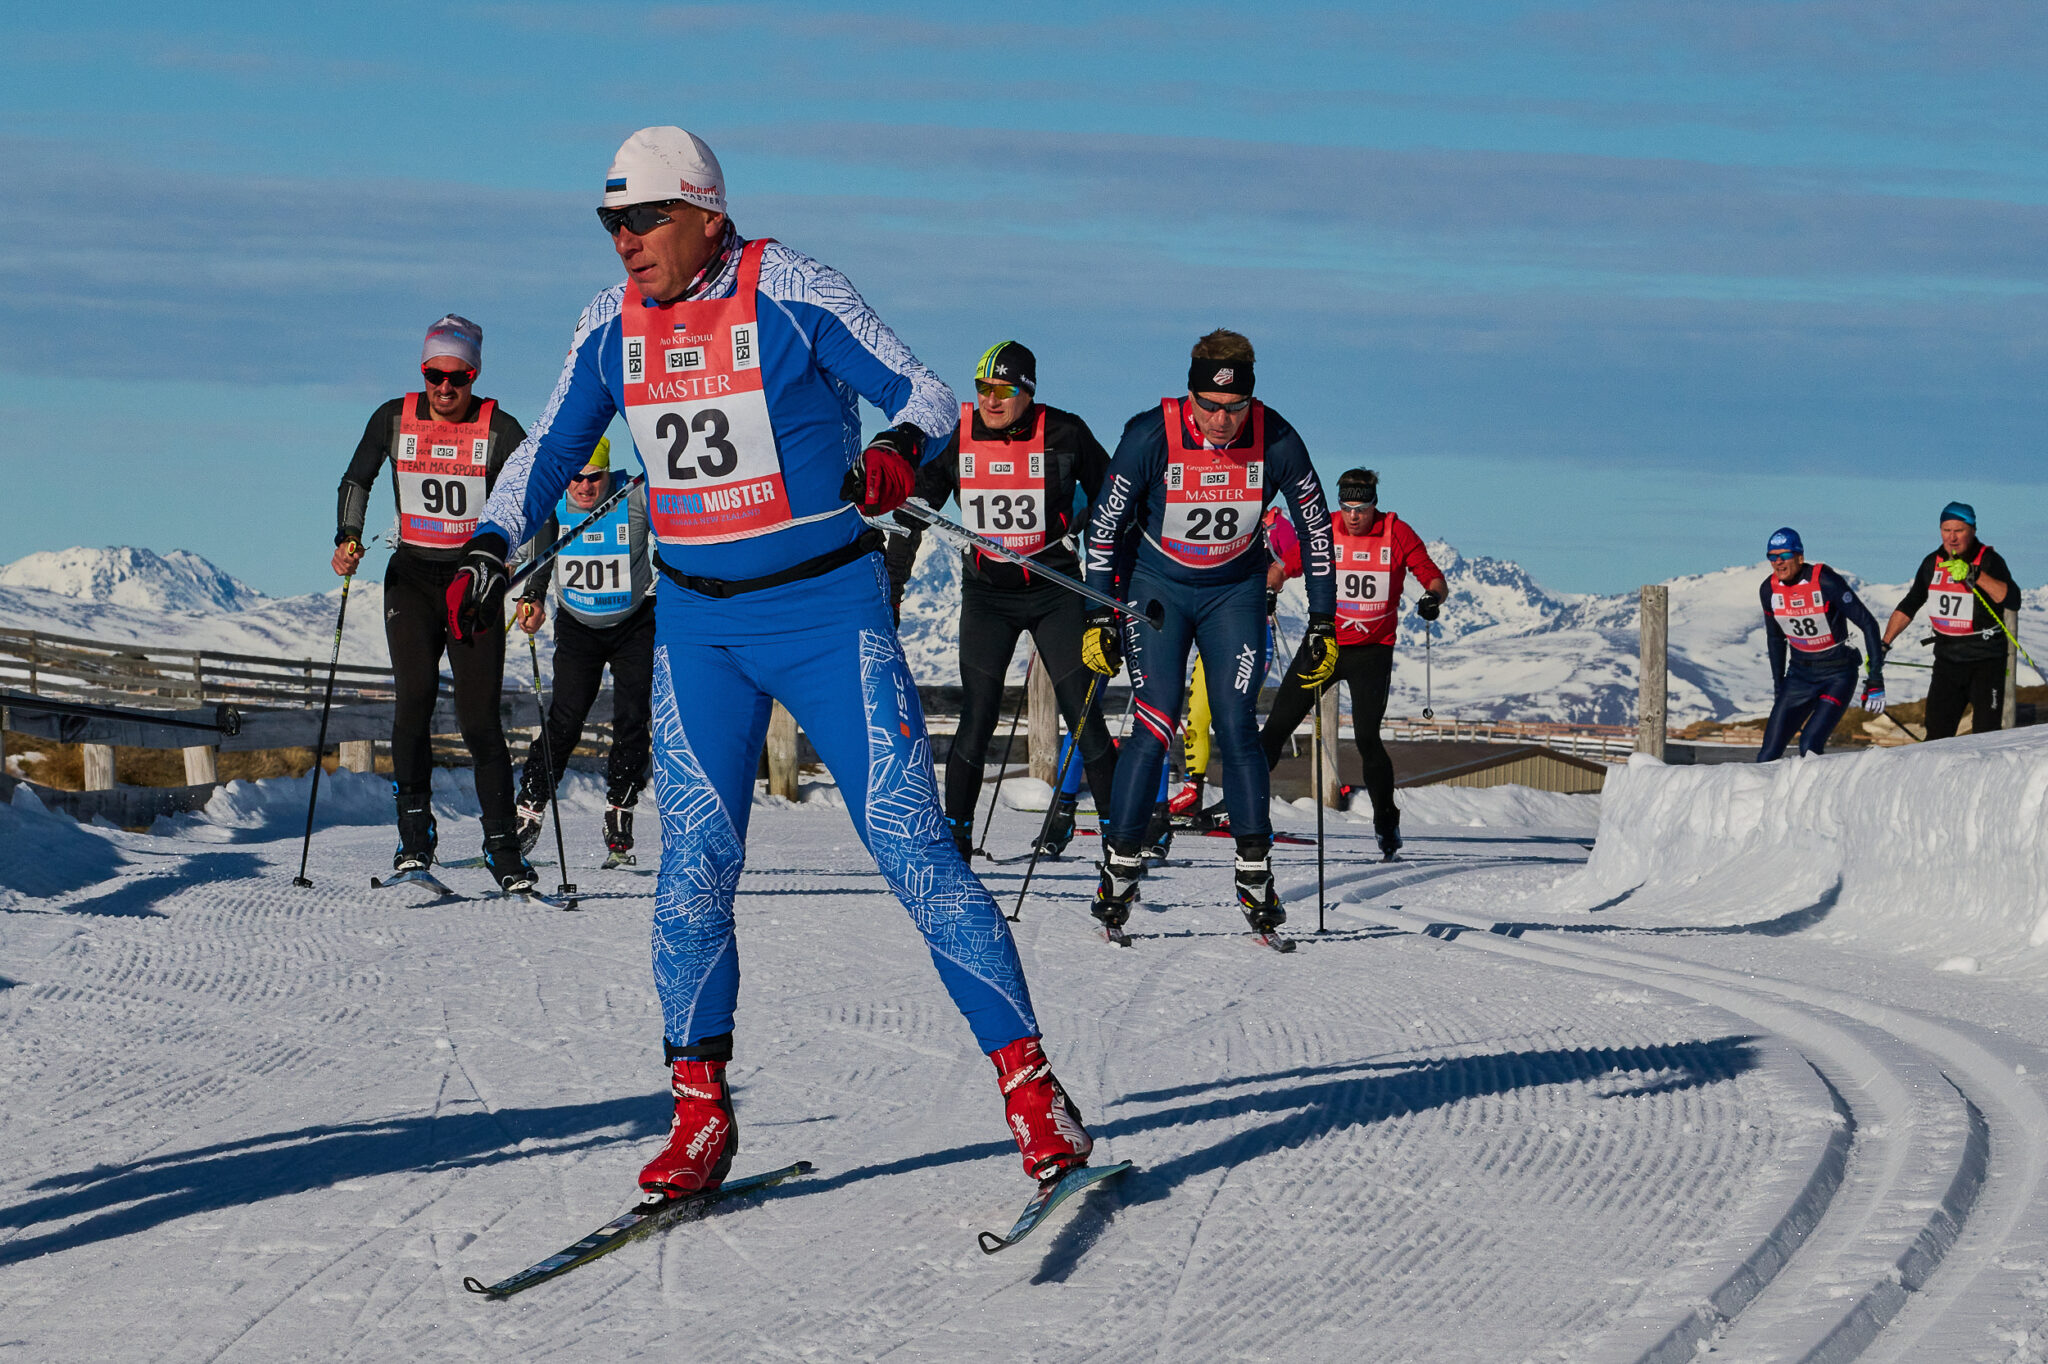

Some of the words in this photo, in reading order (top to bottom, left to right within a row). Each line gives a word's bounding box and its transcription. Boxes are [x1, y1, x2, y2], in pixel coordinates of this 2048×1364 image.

[660, 336, 671, 346] Avo
[672, 333, 713, 346] Kirsipuu
[648, 374, 731, 400] MASTER
[656, 408, 738, 480] 23
[401, 461, 426, 472] TEAM
[430, 462, 450, 474] MAC
[452, 464, 486, 476] SPORT
[422, 478, 466, 517] 90
[1186, 489, 1244, 500] MASTER
[700, 514, 718, 525] NEW
[720, 508, 760, 523] ZEALAND
[969, 494, 1037, 530] 133
[1185, 507, 1240, 540] 28
[444, 520, 478, 534] MUSTE
[565, 560, 620, 590] 201
[1345, 574, 1376, 600] 96
[1940, 594, 1962, 616] 97
[1789, 618, 1818, 636] 38
[676, 1083, 713, 1100] alpina
[1004, 1064, 1034, 1093] alpina
[686, 1116, 720, 1160] alpina
[1010, 1112, 1032, 1148] alpina
